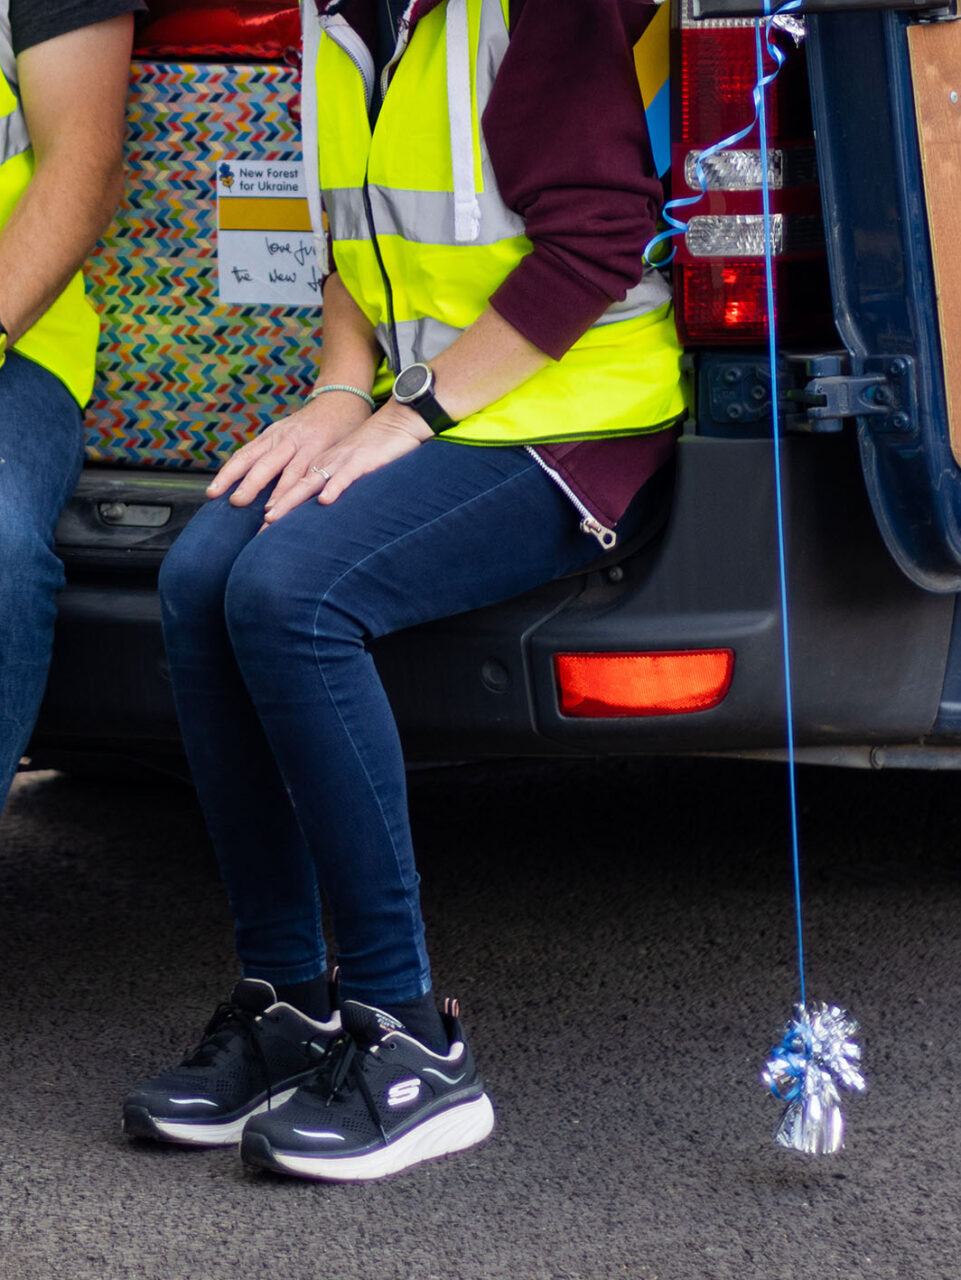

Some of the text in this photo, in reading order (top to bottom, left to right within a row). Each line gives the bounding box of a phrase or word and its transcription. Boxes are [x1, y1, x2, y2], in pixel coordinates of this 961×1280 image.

[240, 168, 299, 179] New Forest
[240, 181, 299, 192] for Ukraine
